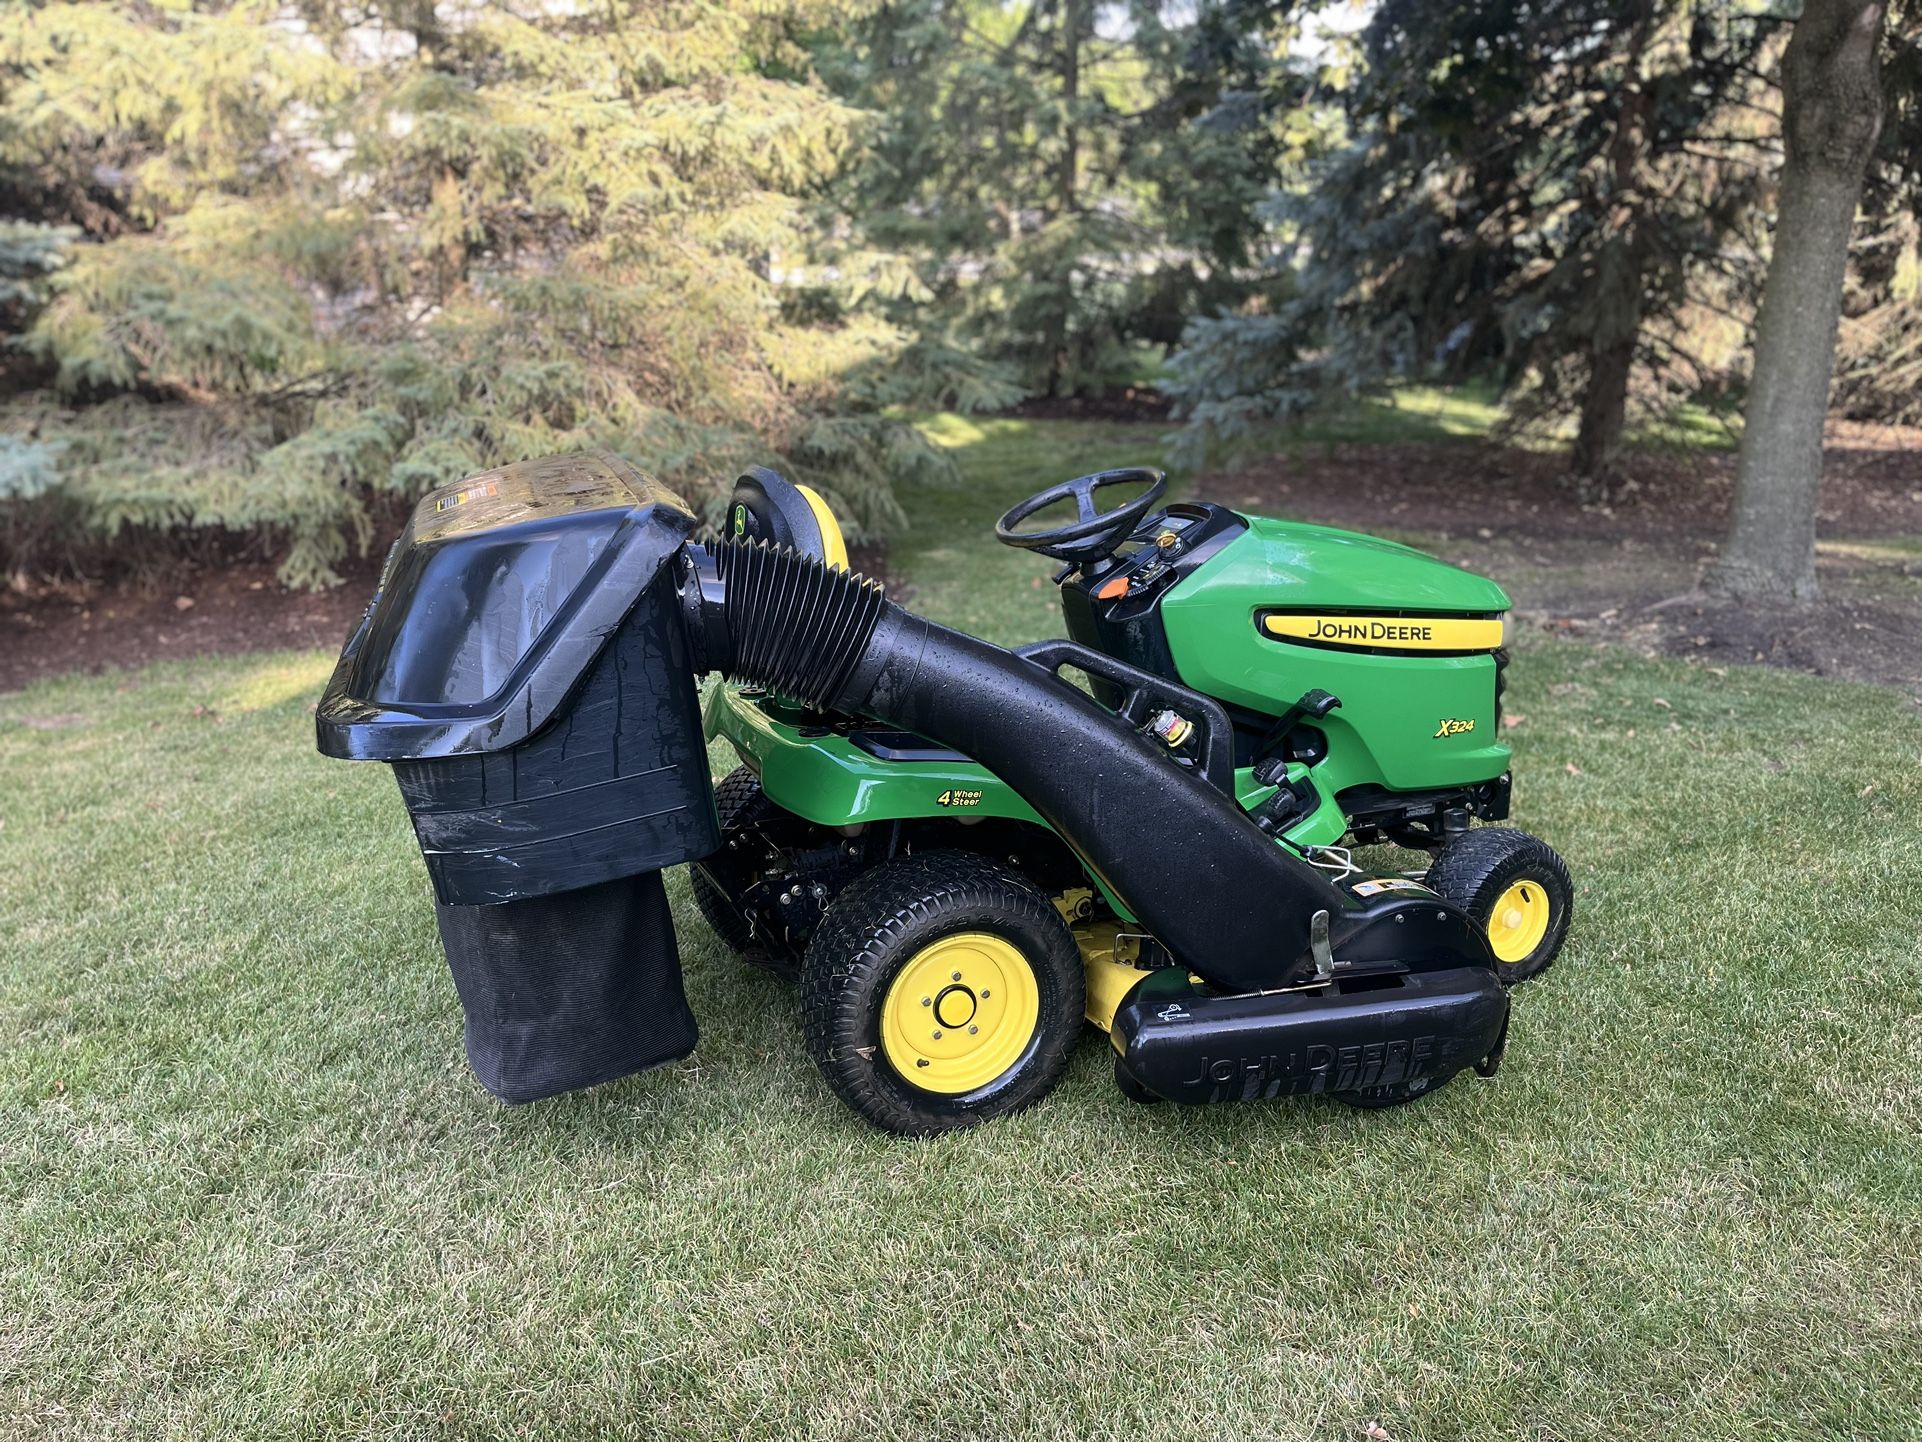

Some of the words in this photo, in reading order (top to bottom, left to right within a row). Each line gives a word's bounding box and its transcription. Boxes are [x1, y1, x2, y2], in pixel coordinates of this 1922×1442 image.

[1308, 620, 1367, 639] JOHN
[1370, 622, 1432, 641] DEERE
[1433, 718, 1475, 739] X324
[936, 790, 952, 807] 4
[953, 790, 983, 798] Wheel
[952, 797, 980, 806] Steer
[1183, 1052, 1297, 1086] JOHN
[1304, 1035, 1436, 1072] DEERE
